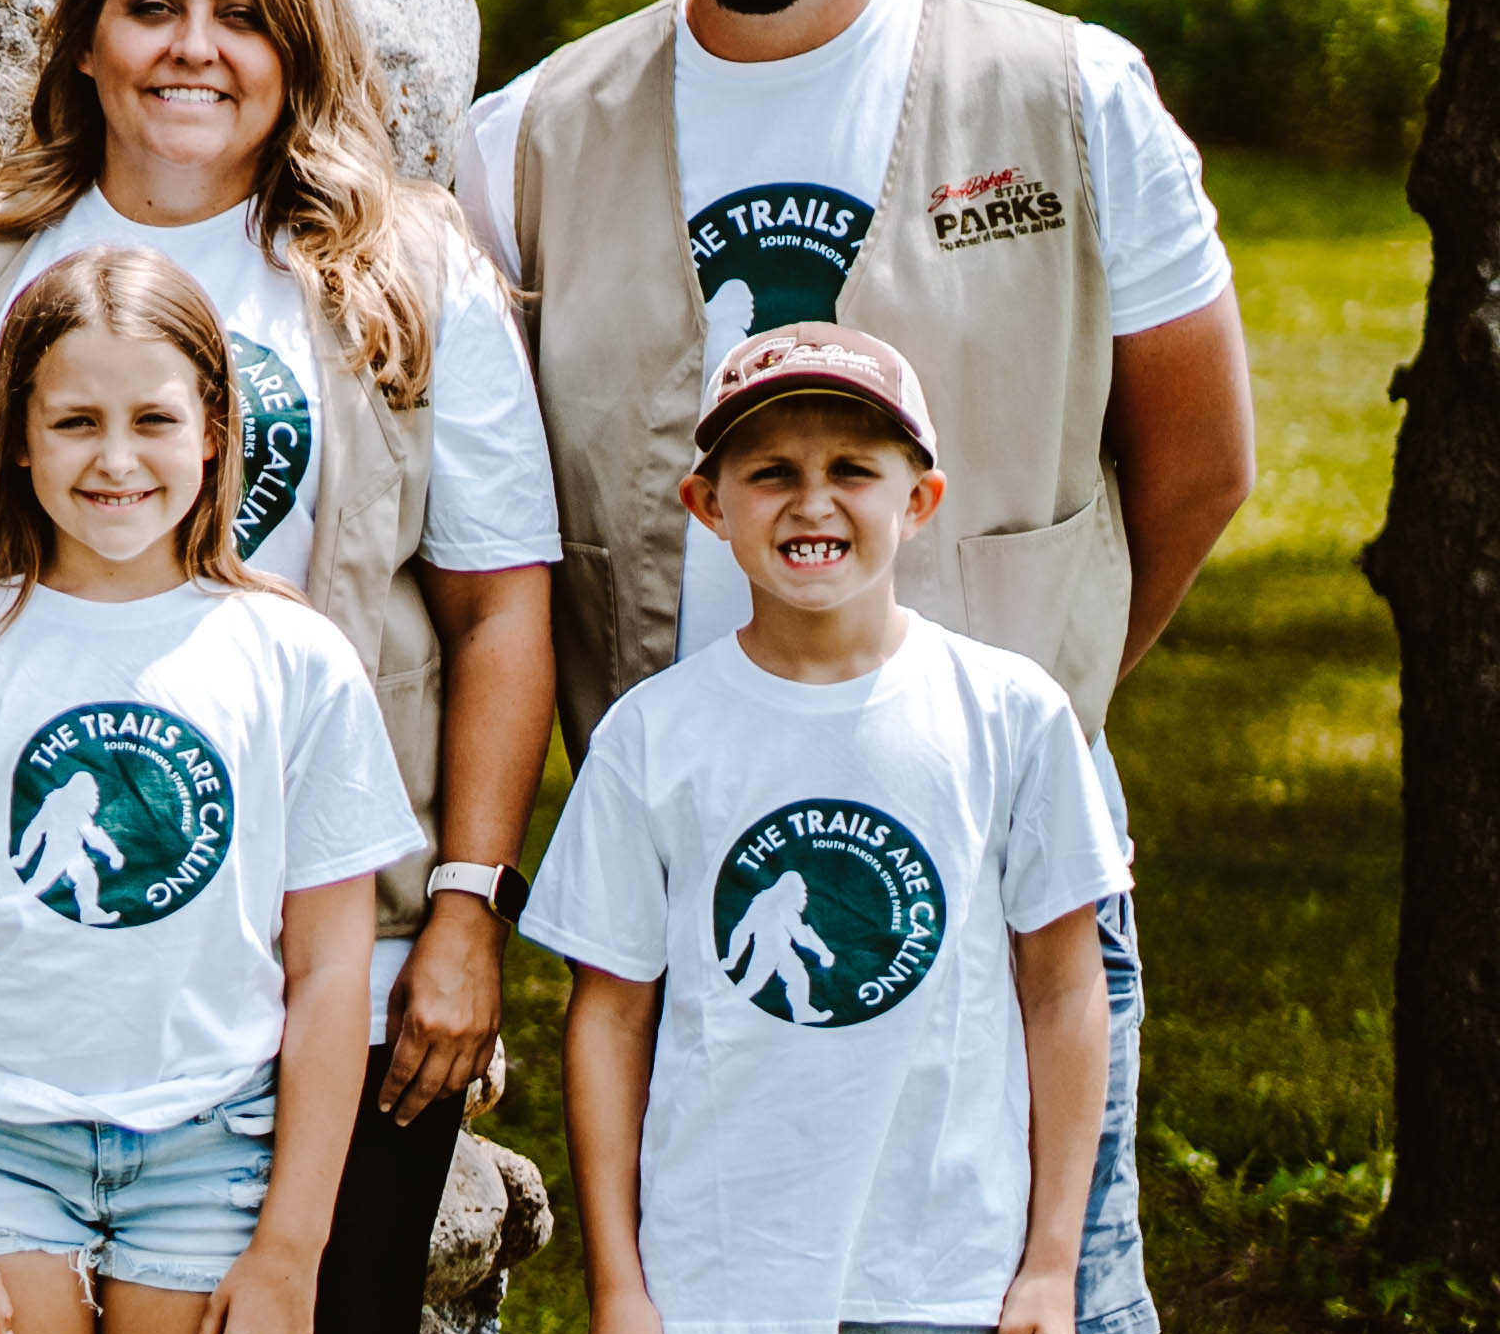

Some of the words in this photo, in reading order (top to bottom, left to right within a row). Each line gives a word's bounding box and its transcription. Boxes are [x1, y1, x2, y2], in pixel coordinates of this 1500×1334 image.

[994, 181, 1044, 199] STATE
[690, 221, 728, 270] HE
[726, 196, 856, 238] TRAILS
[933, 191, 1063, 240] PARKS
[759, 234, 802, 249] SOUTH
[803, 237, 847, 270] DAKOTA
[238, 361, 293, 414] ARE
[243, 416, 257, 459] PARKS
[29, 723, 81, 771] THE
[79, 711, 183, 750] TRAILS
[103, 740, 138, 753] SOUTH
[137, 744, 173, 775] DAKOTA
[176, 747, 222, 797] ARE
[169, 770, 192, 798] STATE
[180, 798, 194, 833] PARKS
[787, 809, 892, 848] TRAILS
[145, 802, 225, 909] CALLING
[736, 823, 787, 872] THE
[886, 847, 931, 895] ARE
[812, 838, 847, 851] SOUTH
[846, 841, 883, 873] DAKOTA
[878, 870, 900, 899] STATE
[890, 898, 902, 932] PARKS
[857, 899, 937, 1007] CALLING
